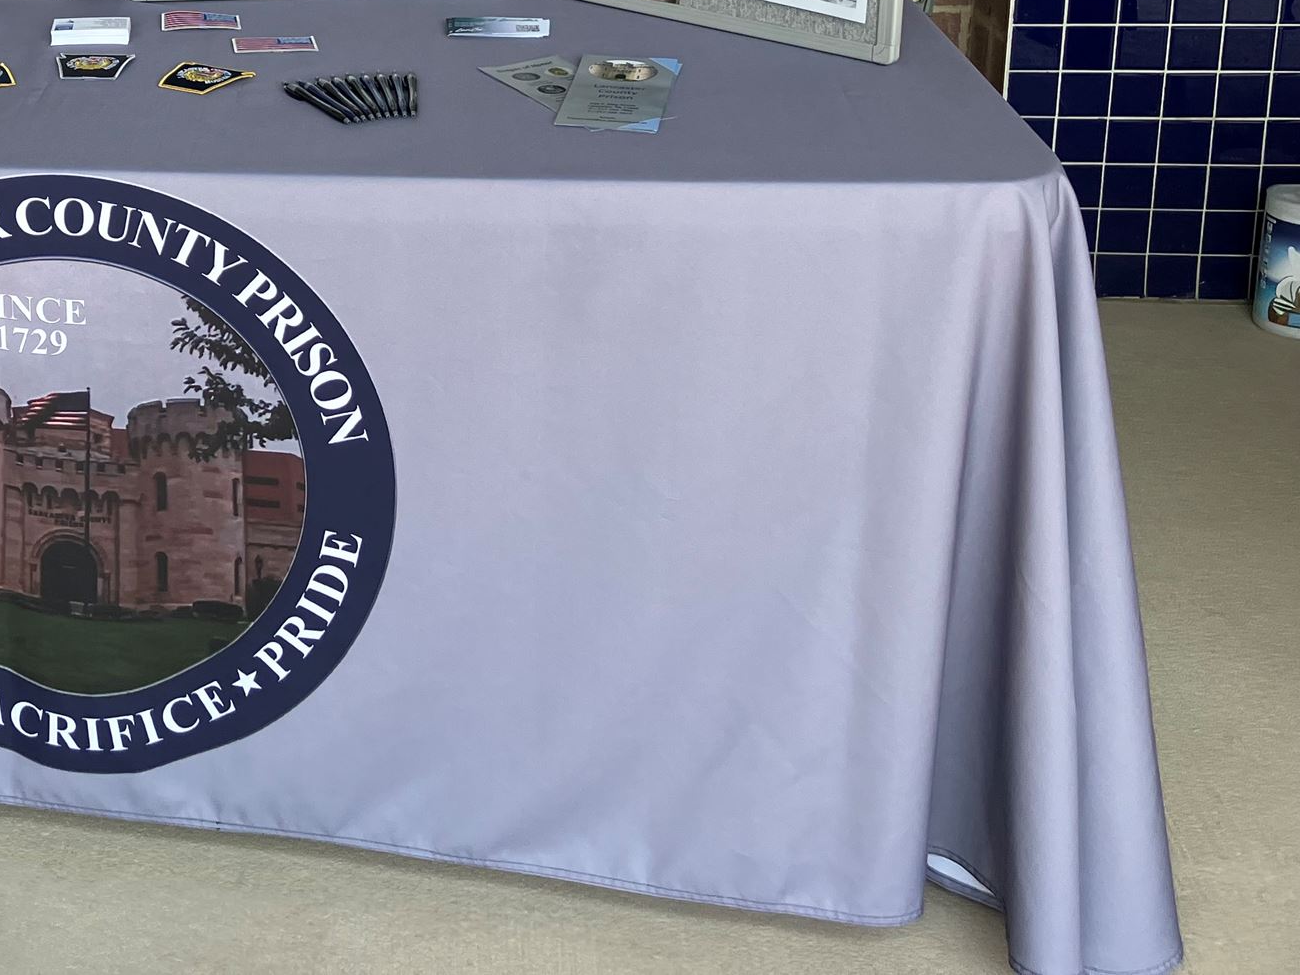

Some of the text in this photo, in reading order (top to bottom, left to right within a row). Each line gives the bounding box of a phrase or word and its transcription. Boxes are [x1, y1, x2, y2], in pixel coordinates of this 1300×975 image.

[15, 196, 248, 288] COUNTY
[232, 268, 370, 449] PRISON
[253, 528, 364, 683] PRIDE
